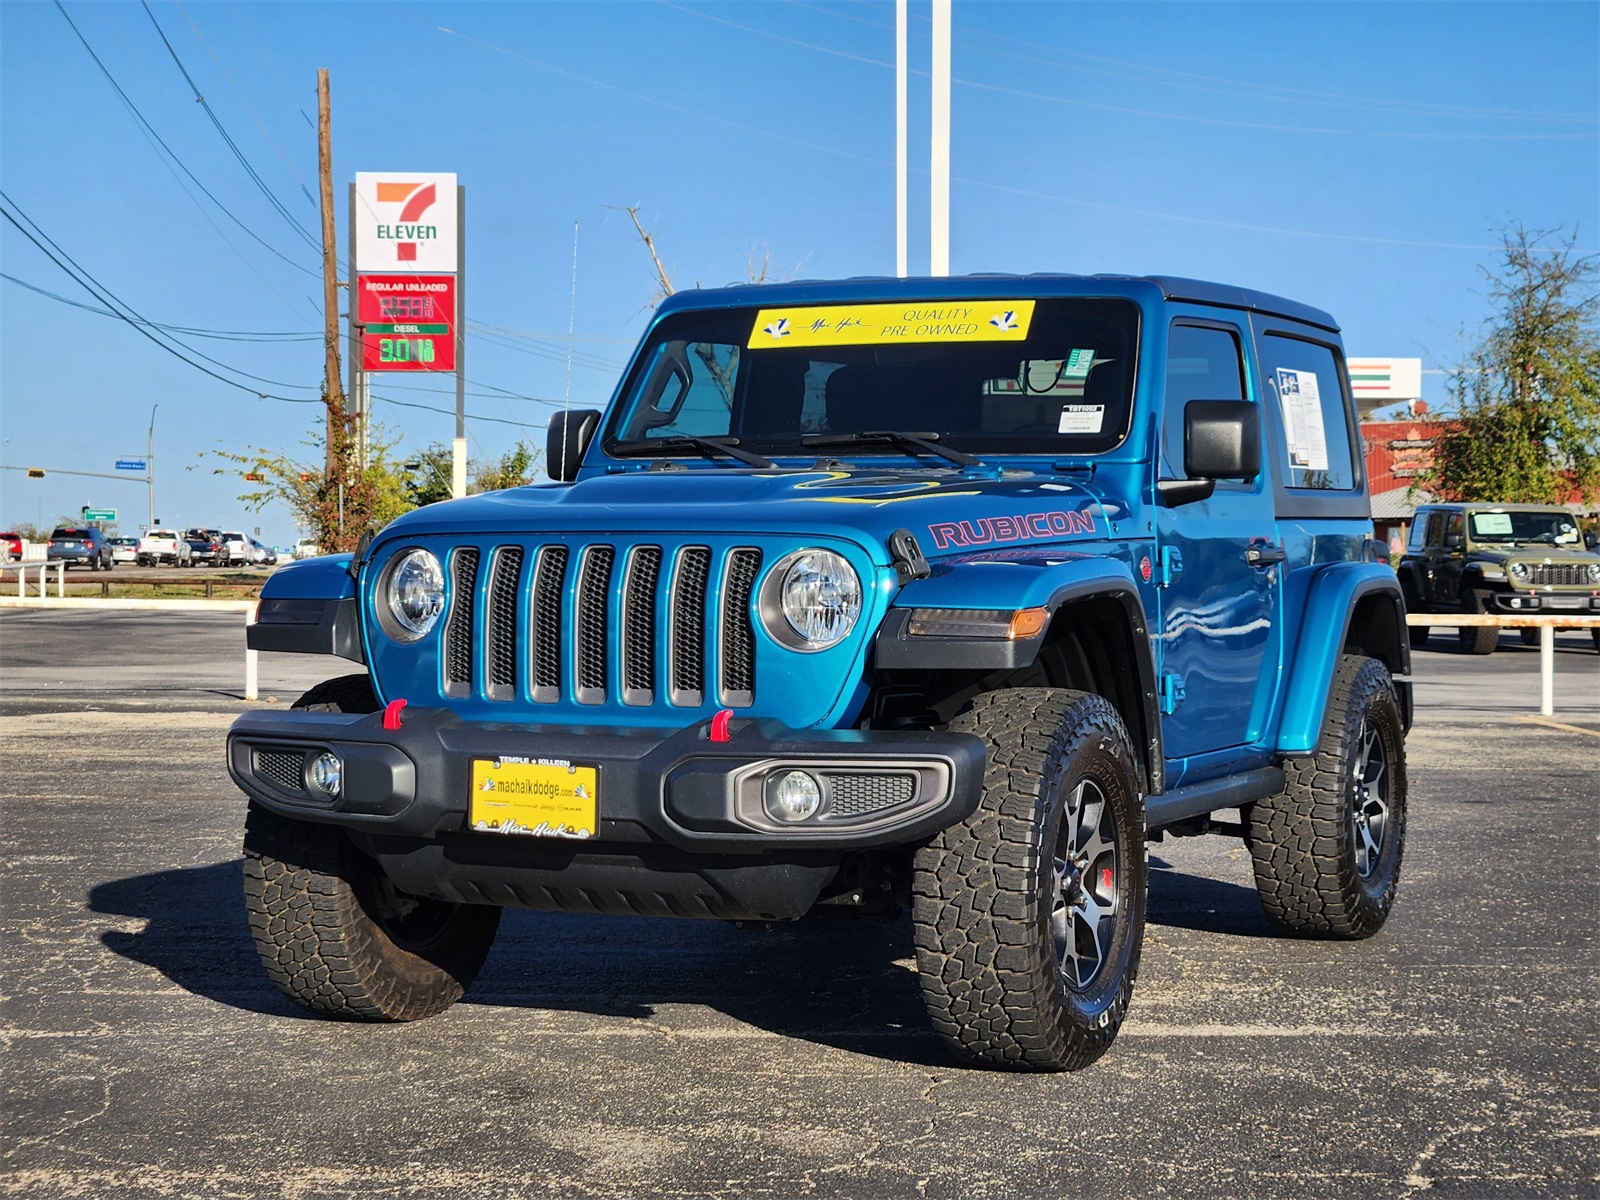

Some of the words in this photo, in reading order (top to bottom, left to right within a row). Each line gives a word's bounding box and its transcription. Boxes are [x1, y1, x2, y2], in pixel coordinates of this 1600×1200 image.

[366, 282, 404, 291] REGULAR
[405, 283, 448, 292] UNLEADED
[903, 308, 973, 321] QUALITY
[380, 339, 423, 362] 3.01
[928, 510, 1096, 549] RUBICON
[499, 756, 530, 764] TEMPLE
[538, 758, 571, 767] KILLEEN
[497, 778, 573, 799] machaikdodge.com
[500, 818, 529, 835] Mac
[531, 821, 566, 838] Haik
